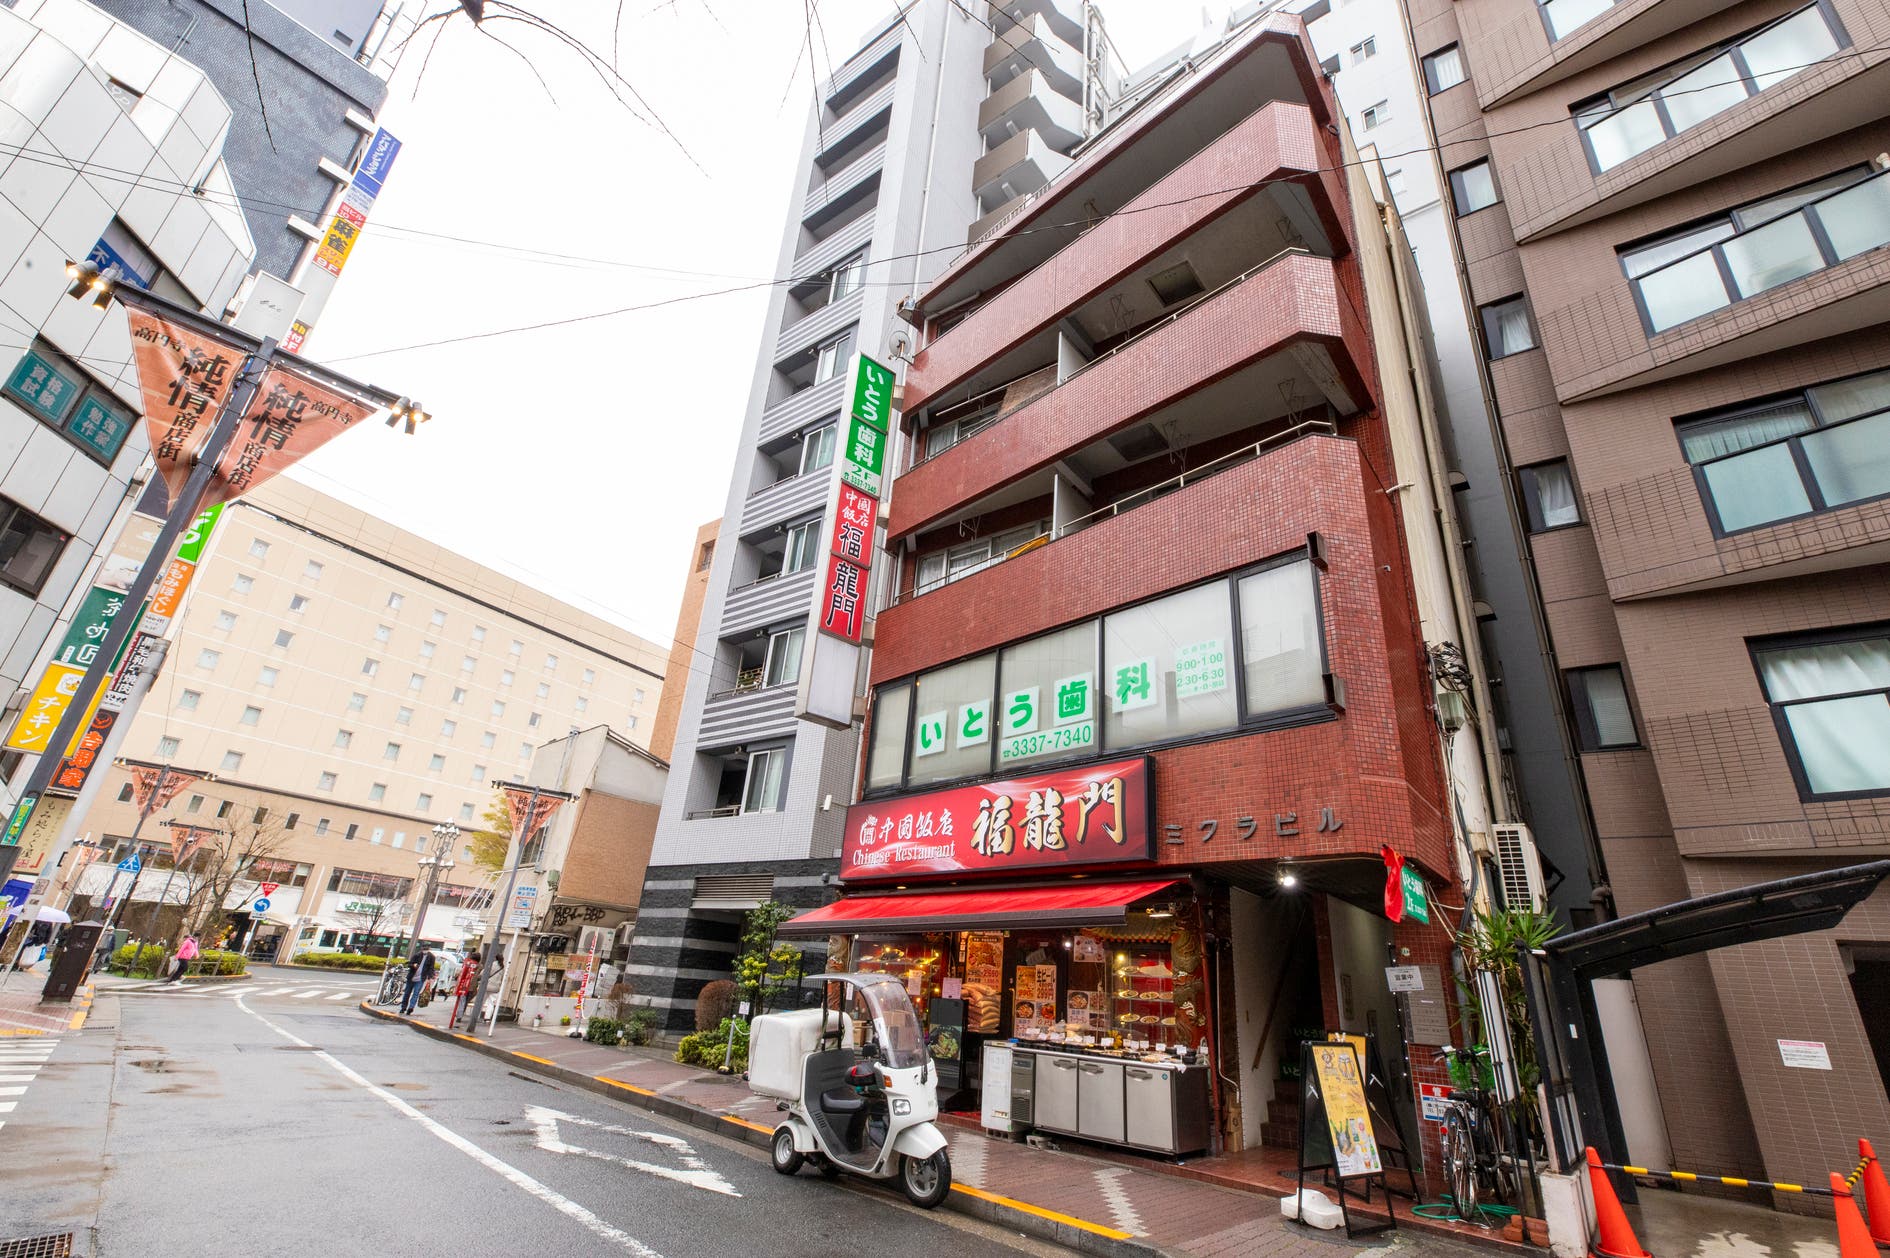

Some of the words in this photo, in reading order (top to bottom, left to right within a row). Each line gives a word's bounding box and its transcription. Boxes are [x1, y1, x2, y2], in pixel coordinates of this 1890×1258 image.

[327, 219, 356, 255] 麻雀
[316, 256, 339, 272] 9F
[134, 326, 187, 353] 高円寺
[310, 399, 353, 425] 高円寺
[853, 364, 885, 467] いとう歯科
[852, 463, 873, 481] 2F
[153, 567, 184, 614] もみほぐし
[826, 522, 864, 636] 福龍門
[19, 695, 61, 744] チキン
[921, 661, 1150, 749] いとう歯科
[1011, 724, 1092, 758] 3337-7340
[970, 776, 1127, 857] 福龍門
[852, 848, 891, 866] Chinese
[894, 841, 956, 862] Restaurant
